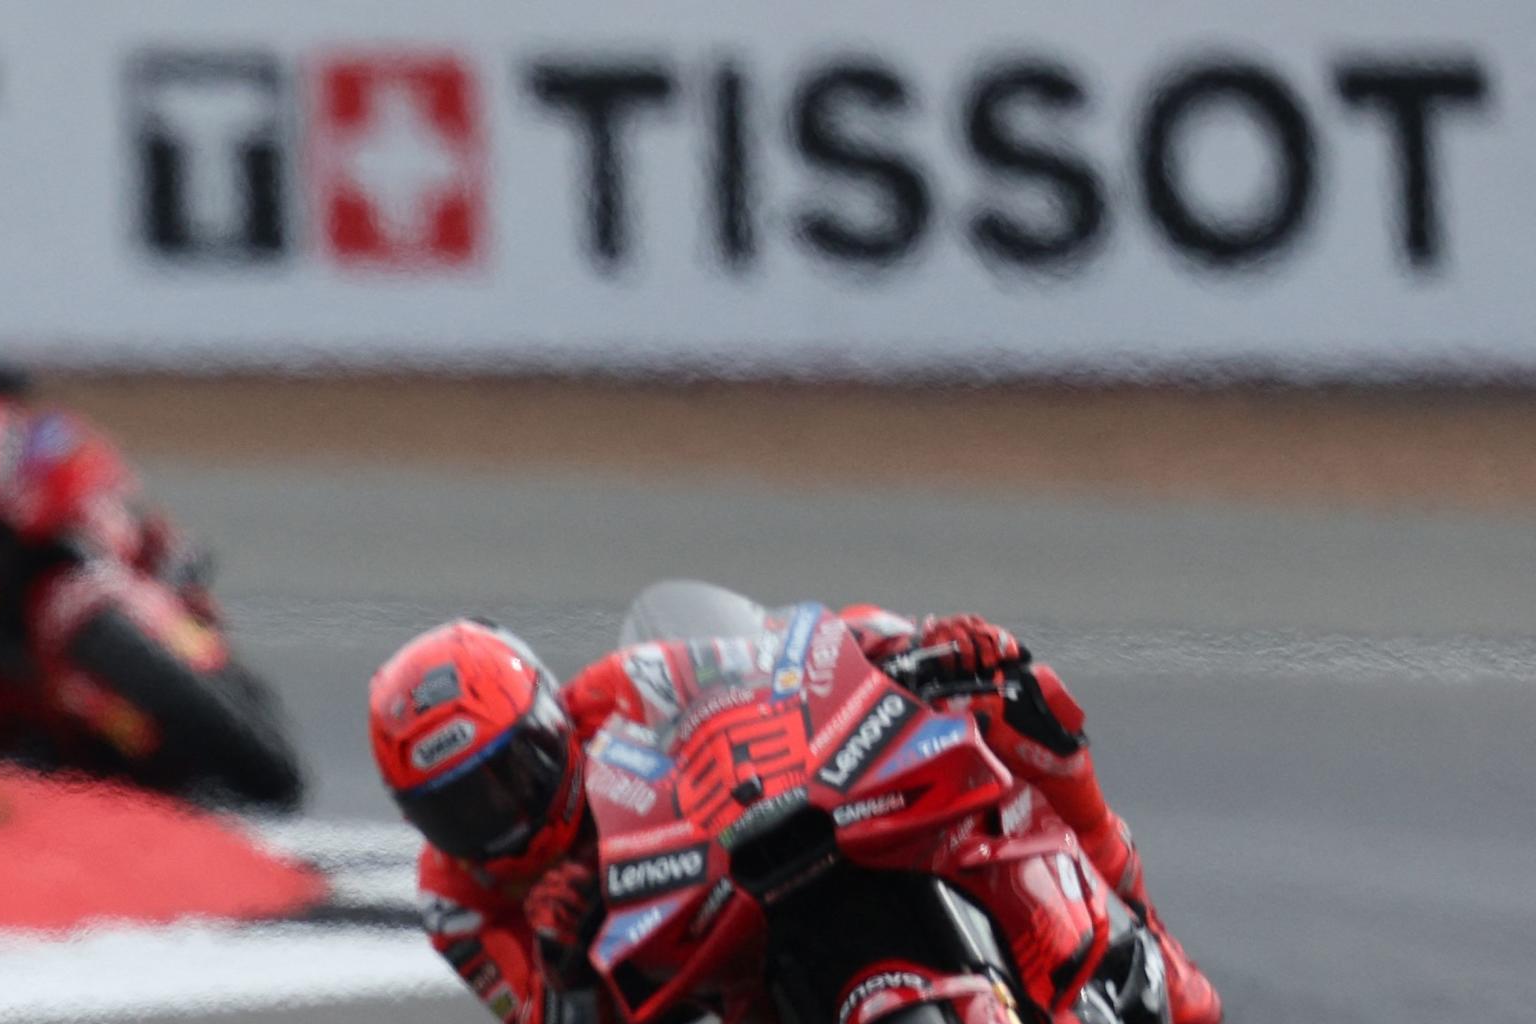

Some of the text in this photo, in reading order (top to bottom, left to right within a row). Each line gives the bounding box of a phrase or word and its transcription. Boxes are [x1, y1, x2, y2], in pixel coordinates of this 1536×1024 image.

[522, 54, 1492, 272] TISSOT
[819, 694, 906, 787] Lenovo
[607, 848, 704, 897] Lenovo
